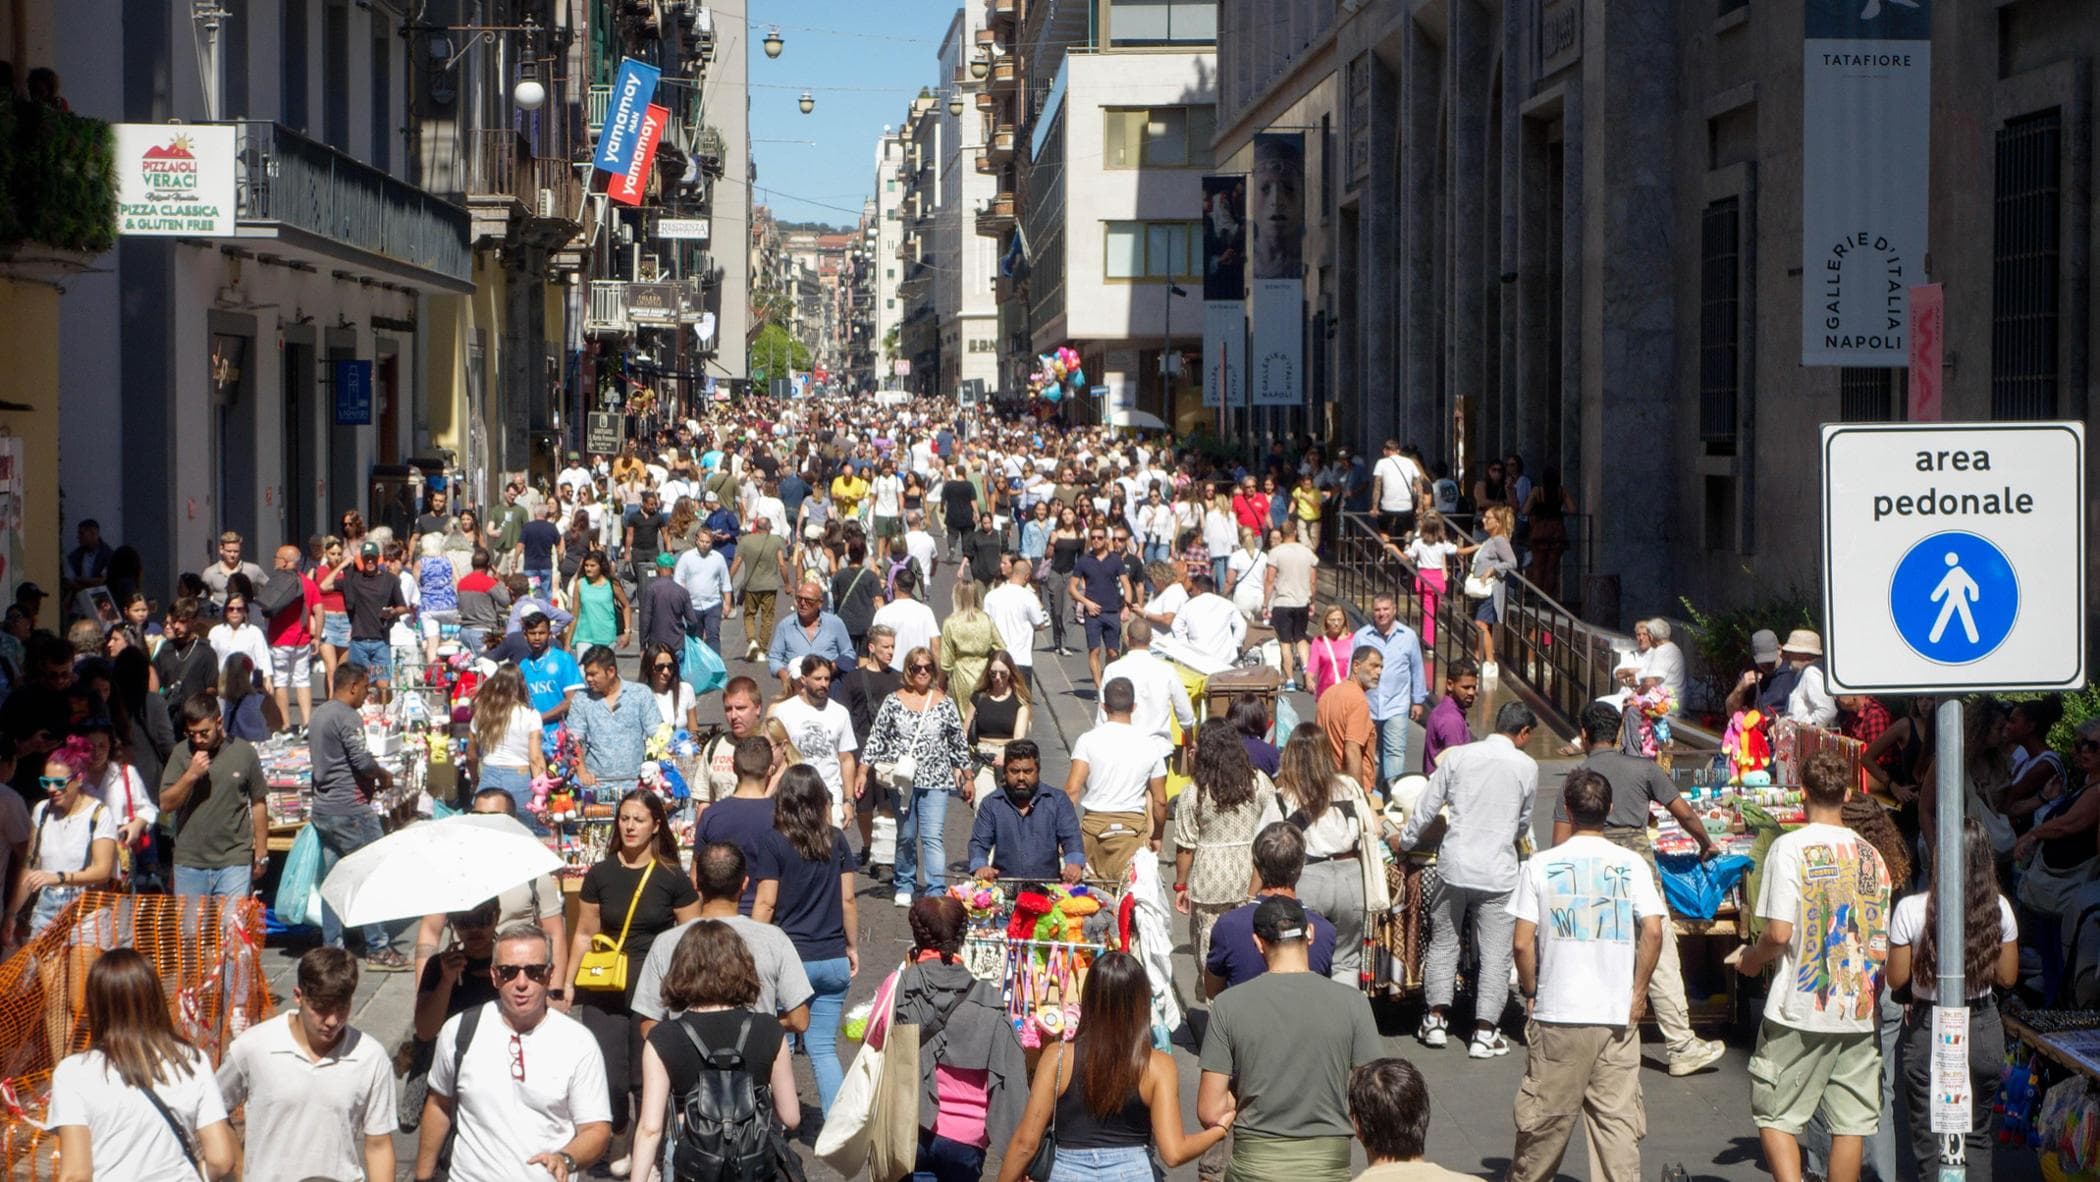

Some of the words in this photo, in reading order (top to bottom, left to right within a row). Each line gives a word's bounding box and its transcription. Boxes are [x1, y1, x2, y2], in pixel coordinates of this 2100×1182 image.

[1823, 54, 1911, 66] TATAFIORE
[604, 73, 641, 163] yamamay
[628, 112, 640, 134] MAN
[622, 115, 657, 196] yamamay
[142, 161, 197, 173] PIZZAIOLI
[142, 174, 197, 188] VERACI
[120, 204, 158, 216] PIZZA
[161, 205, 219, 217] CLASSICA
[125, 218, 135, 230] &
[138, 219, 183, 230] GLUTEN
[187, 220, 214, 231] FREE
[1826, 232, 1869, 330] GALLERIE
[1874, 236, 1902, 330] D'ITALIA
[1826, 335, 1901, 349] NAPOLI
[1916, 450, 1991, 472] area
[1874, 486, 2034, 521] pedonale
